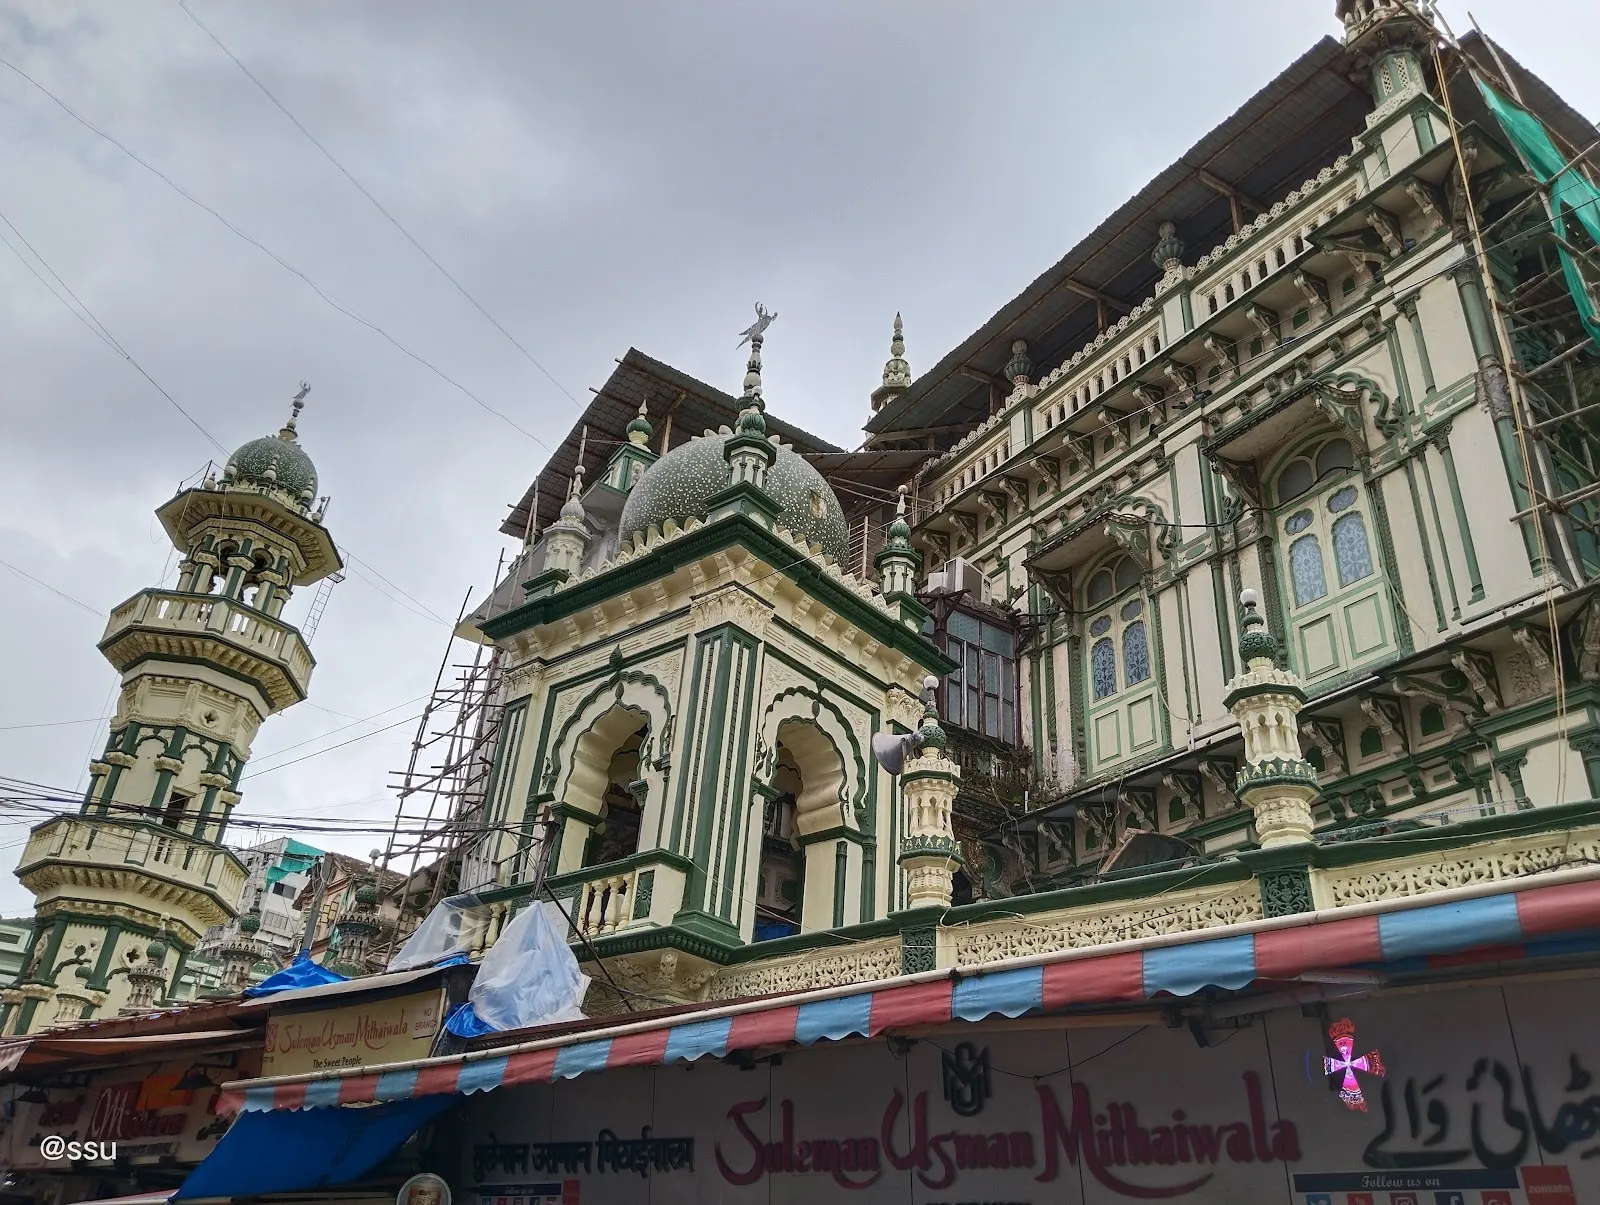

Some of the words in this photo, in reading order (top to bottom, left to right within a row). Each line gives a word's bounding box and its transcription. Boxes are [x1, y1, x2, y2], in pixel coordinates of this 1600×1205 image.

[424, 1007, 432, 1017] NO
[279, 1024, 321, 1054] Suleman
[322, 1018, 355, 1050] Usman
[352, 1008, 408, 1050] Mithaiwala
[313, 1059, 323, 1069] The
[324, 1057, 341, 1068] Sweet
[341, 1055, 362, 1067] People
[716, 1096, 882, 1189] Suleman
[880, 1087, 1036, 1190] Usman
[1034, 1070, 1303, 1199] Mithaiwala
[1360, 1175, 1404, 1189] Follow
[1406, 1178, 1422, 1188] us
[1426, 1177, 1441, 1187] on
[1528, 1183, 1571, 1195] zomato
